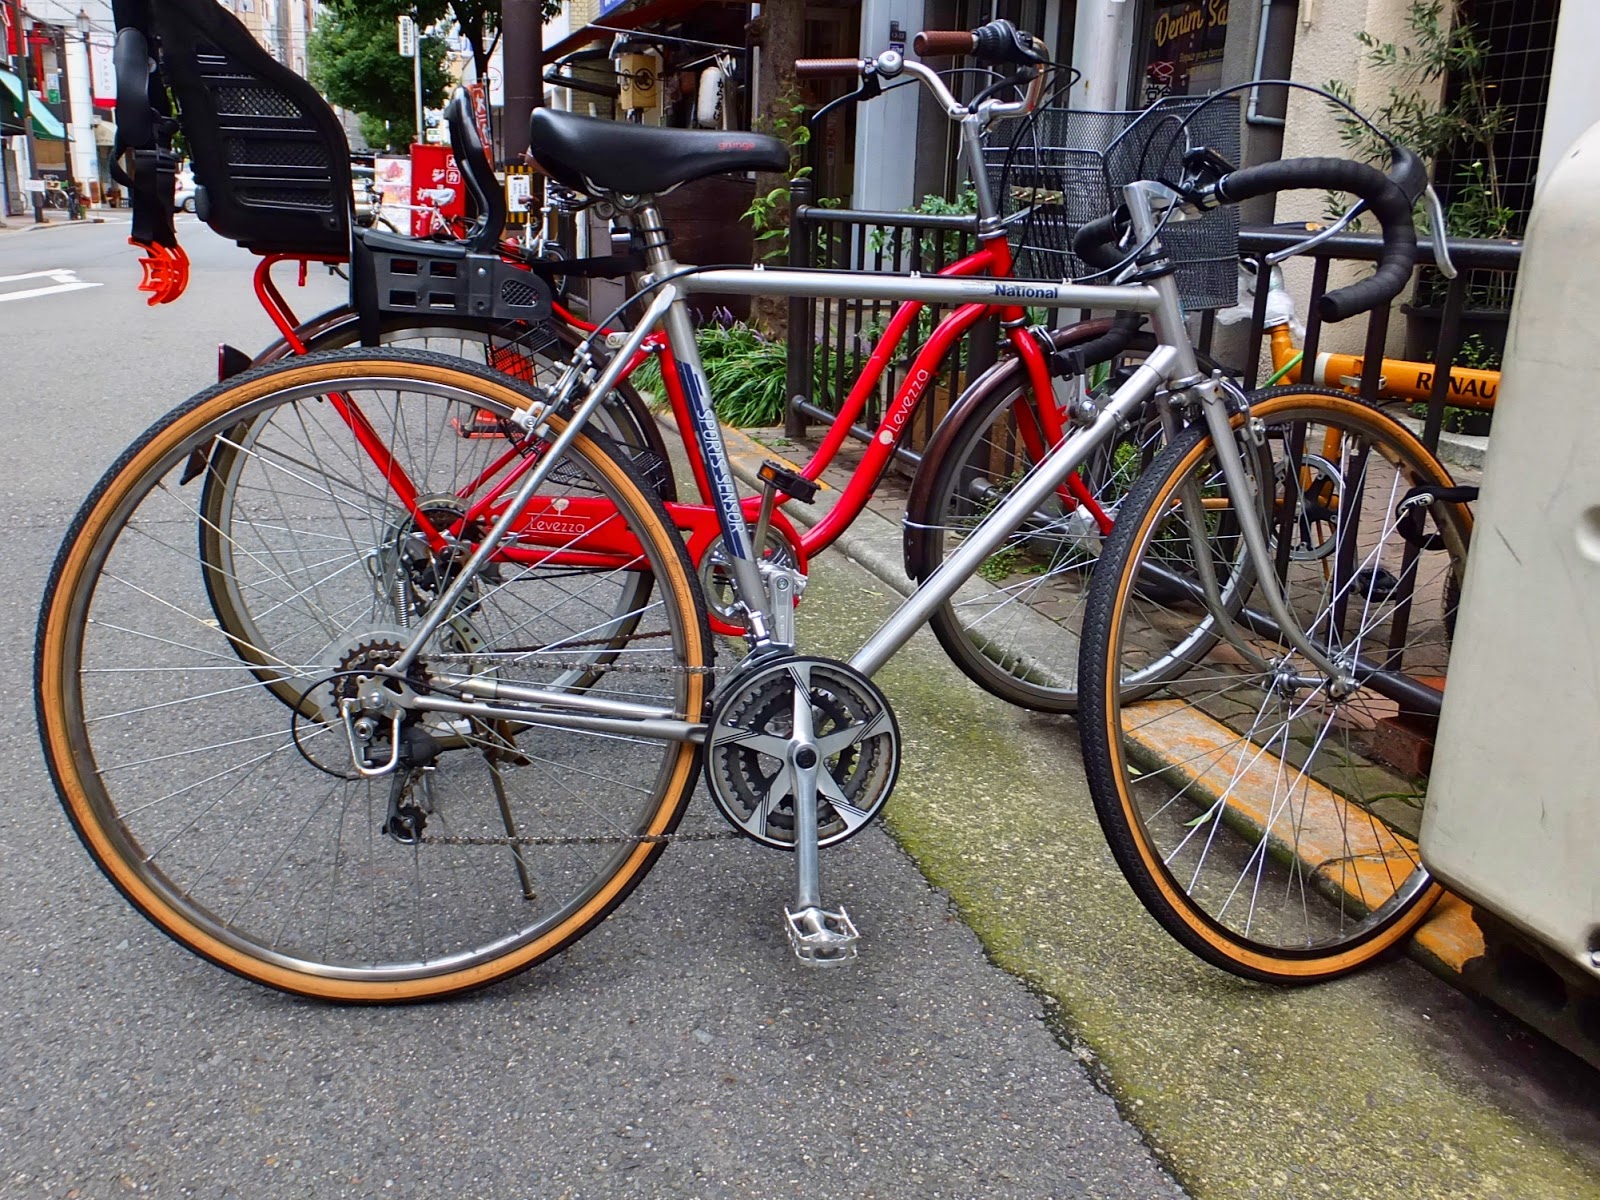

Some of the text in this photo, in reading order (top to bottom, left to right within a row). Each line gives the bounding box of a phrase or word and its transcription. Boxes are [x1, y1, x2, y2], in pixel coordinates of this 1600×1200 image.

[1155, 5, 1204, 48] Denim
[995, 284, 1058, 299] National
[885, 369, 929, 432] Levezza
[1416, 371, 1496, 399] RNAU
[697, 409, 745, 534] SPORTS SENSOR
[529, 516, 585, 533] Levezza
